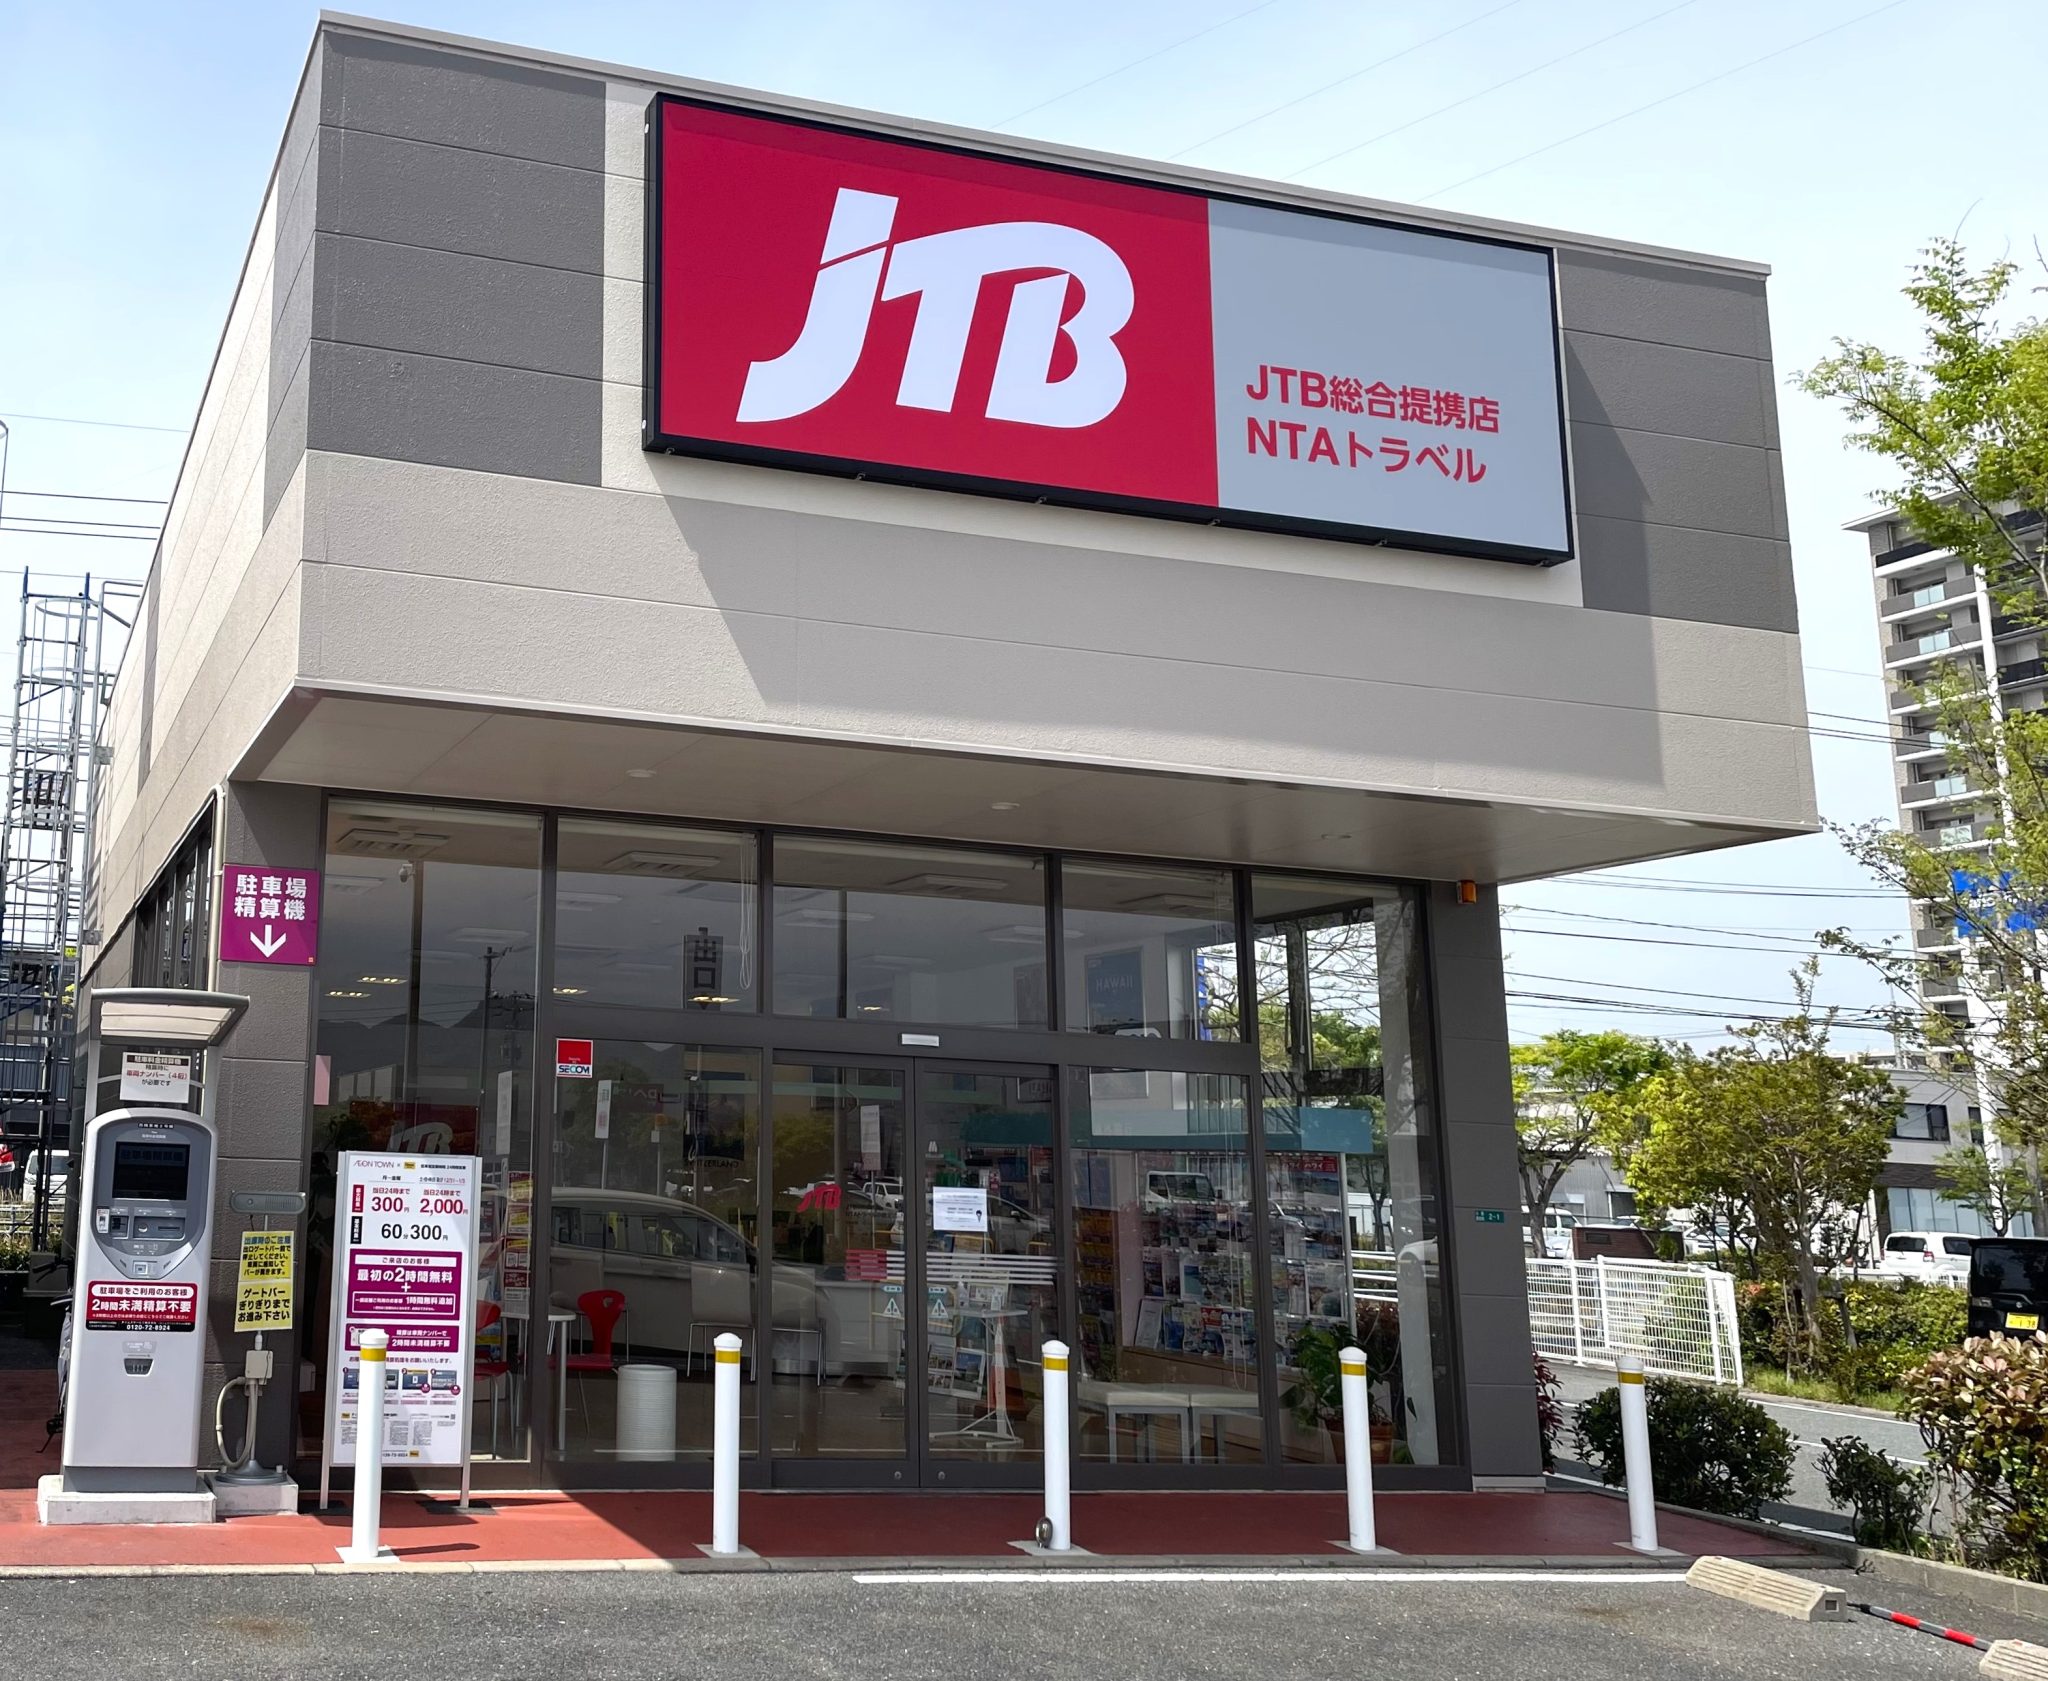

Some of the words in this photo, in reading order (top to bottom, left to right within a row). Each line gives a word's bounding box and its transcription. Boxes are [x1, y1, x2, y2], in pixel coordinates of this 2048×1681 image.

[736, 187, 1135, 430] JTB
[1246, 364, 1500, 434] JTB総合提携店
[1247, 416, 1487, 483] NTAトラベル
[236, 874, 307, 899] 駐車場
[234, 896, 306, 921] 精算機
[559, 1065, 590, 1074] SECOM
[374, 1160, 394, 1169] TOWN
[796, 1183, 842, 1213] JTB
[382, 1257, 430, 1265] ご来店のお客様
[357, 1267, 453, 1284] 最初の2時間無料
[99, 1286, 188, 1296] 駐車場をご利用のお客様
[243, 1287, 286, 1299] ゲートバー
[91, 1298, 192, 1313] 2時間未満精算不要
[239, 1299, 290, 1311] ぎりぎりまで
[237, 1310, 290, 1323] お進み下さい
